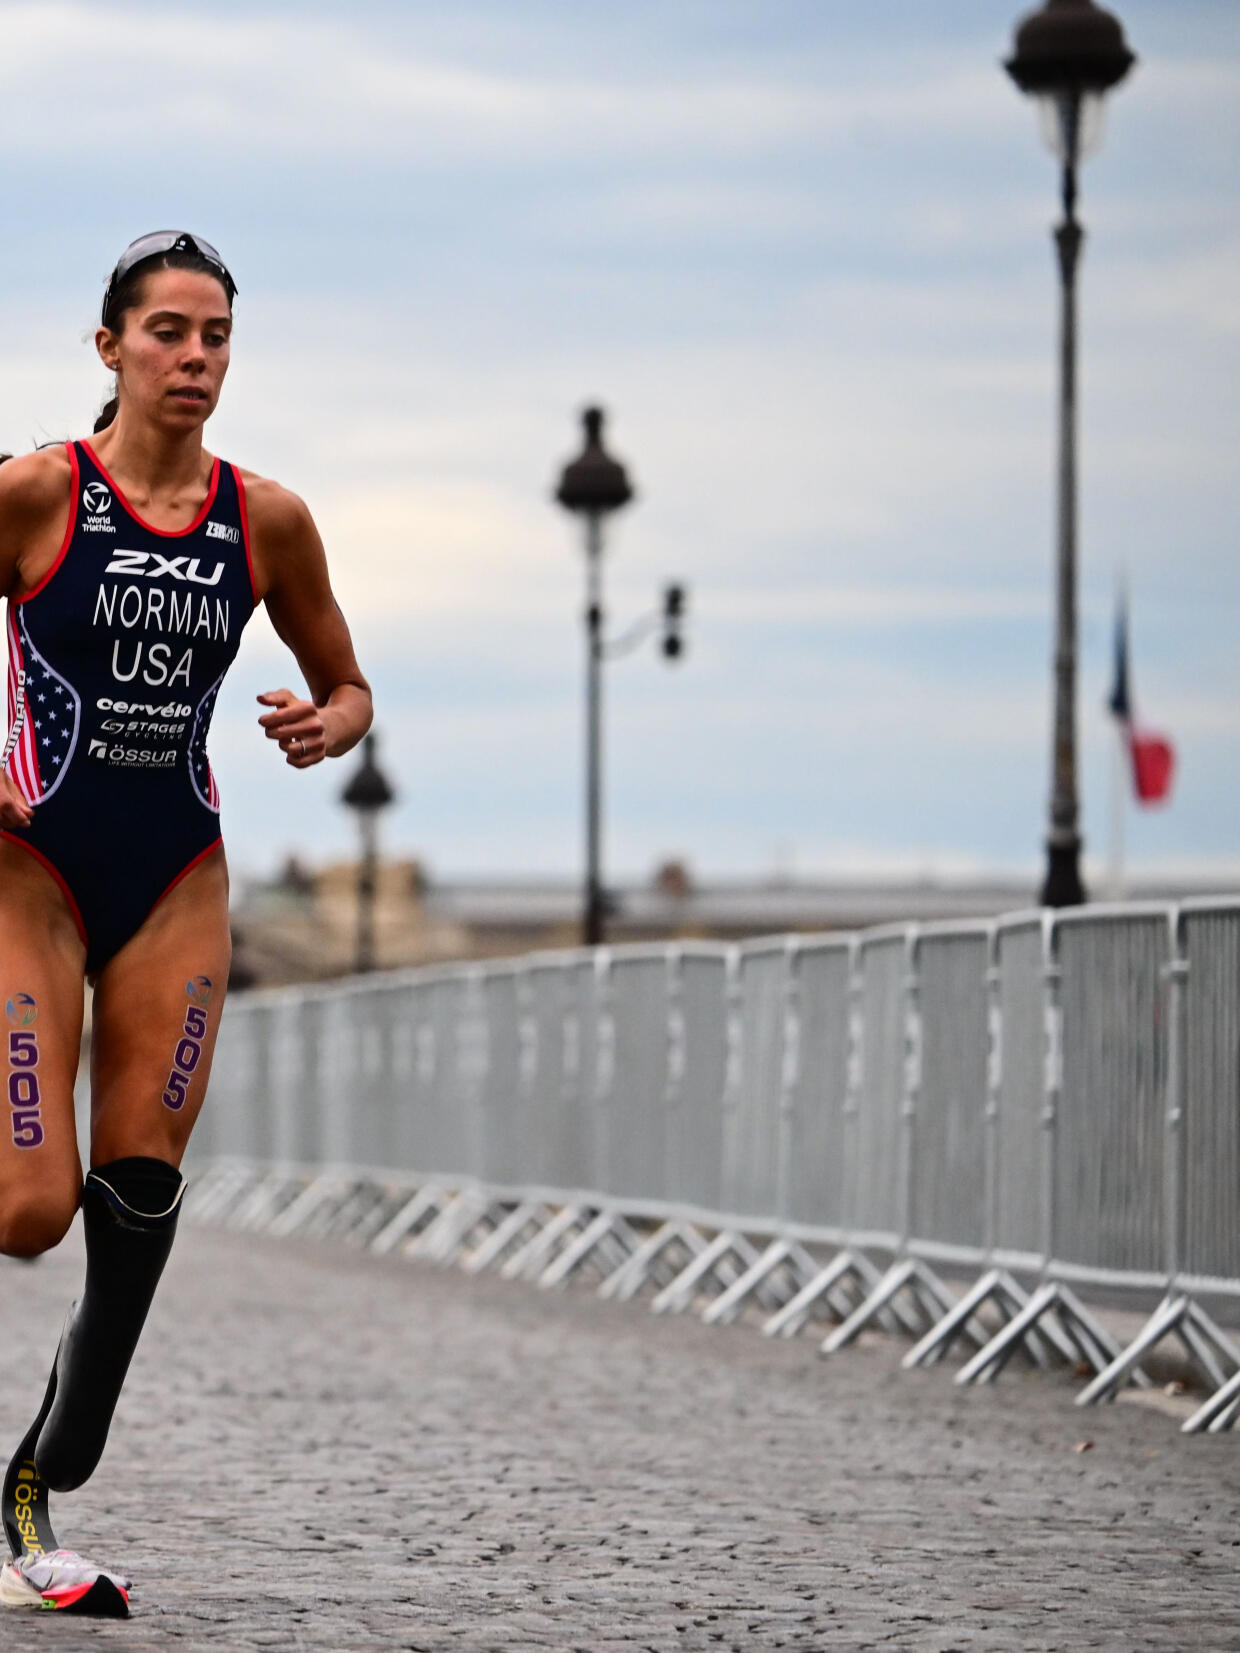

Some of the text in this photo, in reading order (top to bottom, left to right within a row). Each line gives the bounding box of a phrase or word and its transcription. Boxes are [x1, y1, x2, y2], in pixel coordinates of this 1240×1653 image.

[82, 523, 116, 534] Triathlon
[86, 515, 111, 525] World
[104, 548, 226, 586] 2XU
[92, 583, 230, 643] NORMAN
[111, 639, 193, 688] USA
[96, 697, 192, 718] cervélo
[126, 721, 186, 734] STAGES
[109, 743, 177, 763] ÖSSUR
[161, 1004, 208, 1112] 505
[8, 1029, 45, 1149] 505
